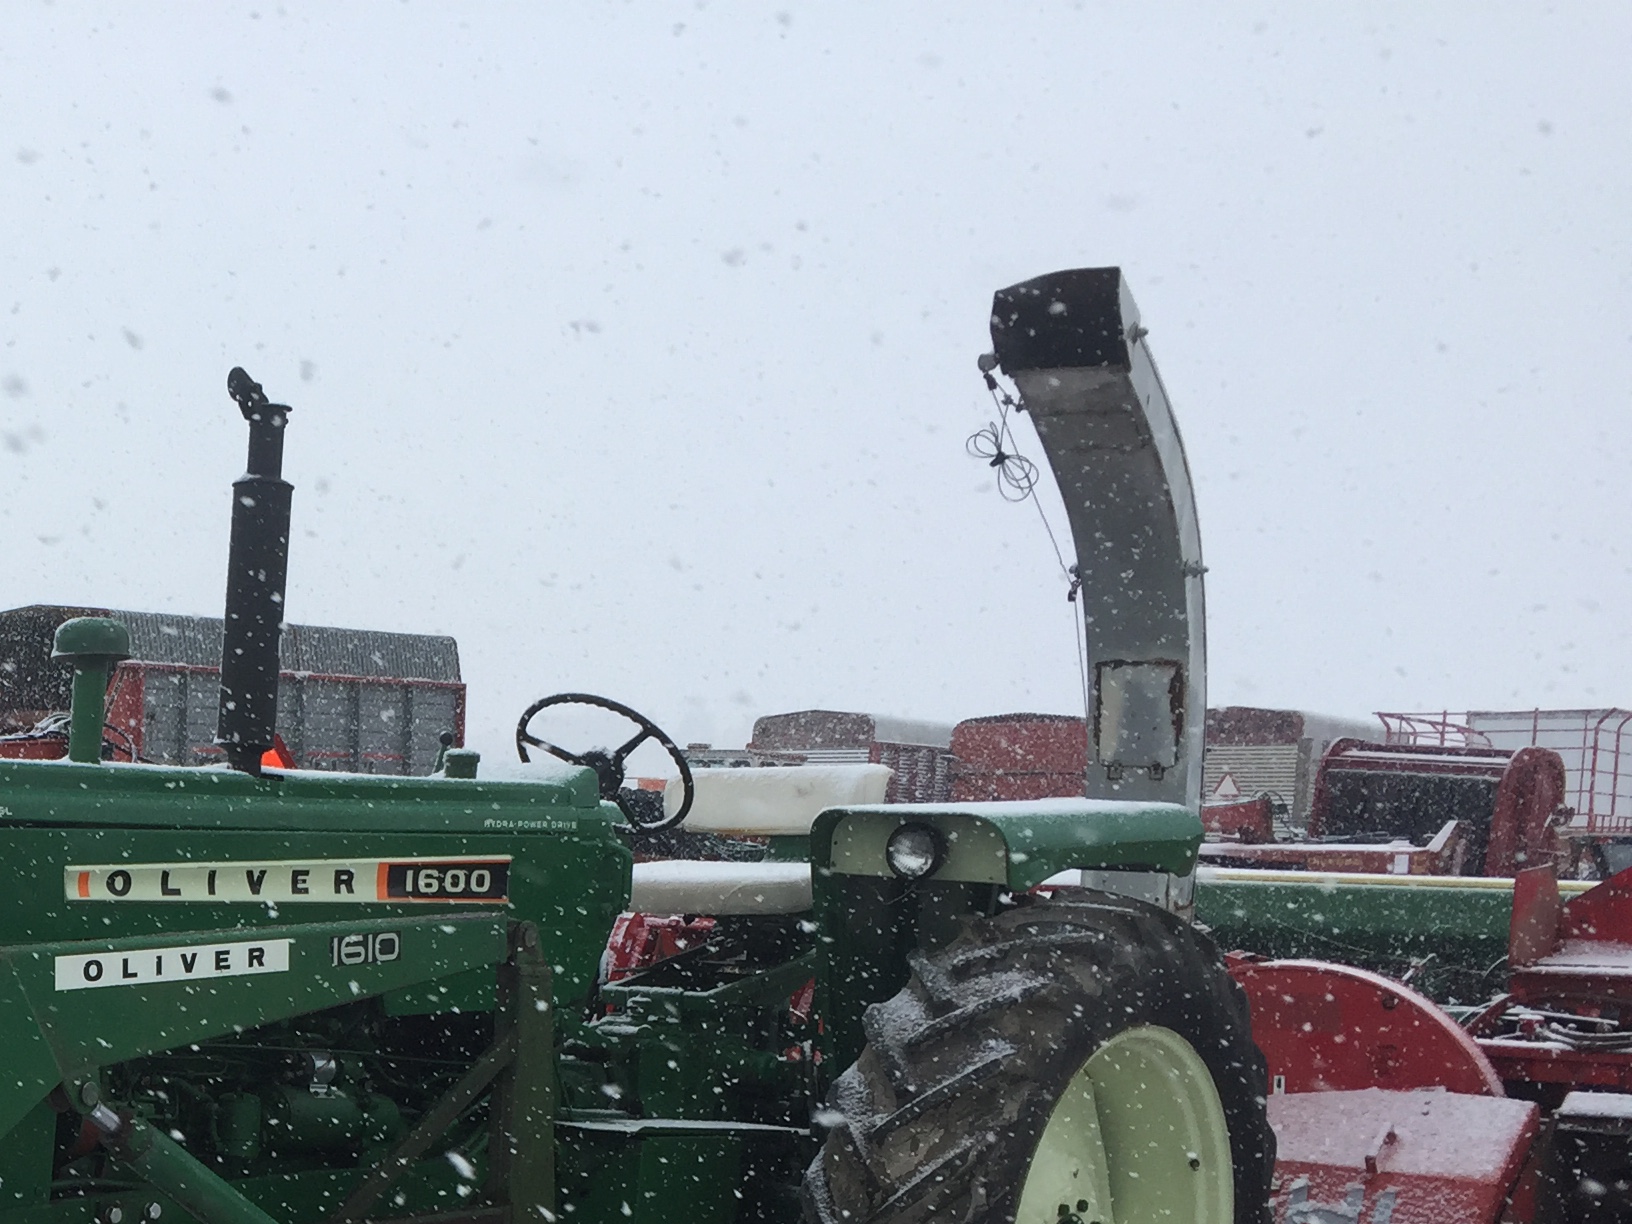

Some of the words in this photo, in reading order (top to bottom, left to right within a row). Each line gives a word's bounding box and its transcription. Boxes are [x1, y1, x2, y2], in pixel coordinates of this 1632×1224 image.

[551, 821, 577, 829] DRIVE
[106, 869, 356, 897] OLIVER
[405, 868, 491, 893] 1600
[83, 947, 267, 982] OLIVER
[331, 932, 400, 966] 1610
